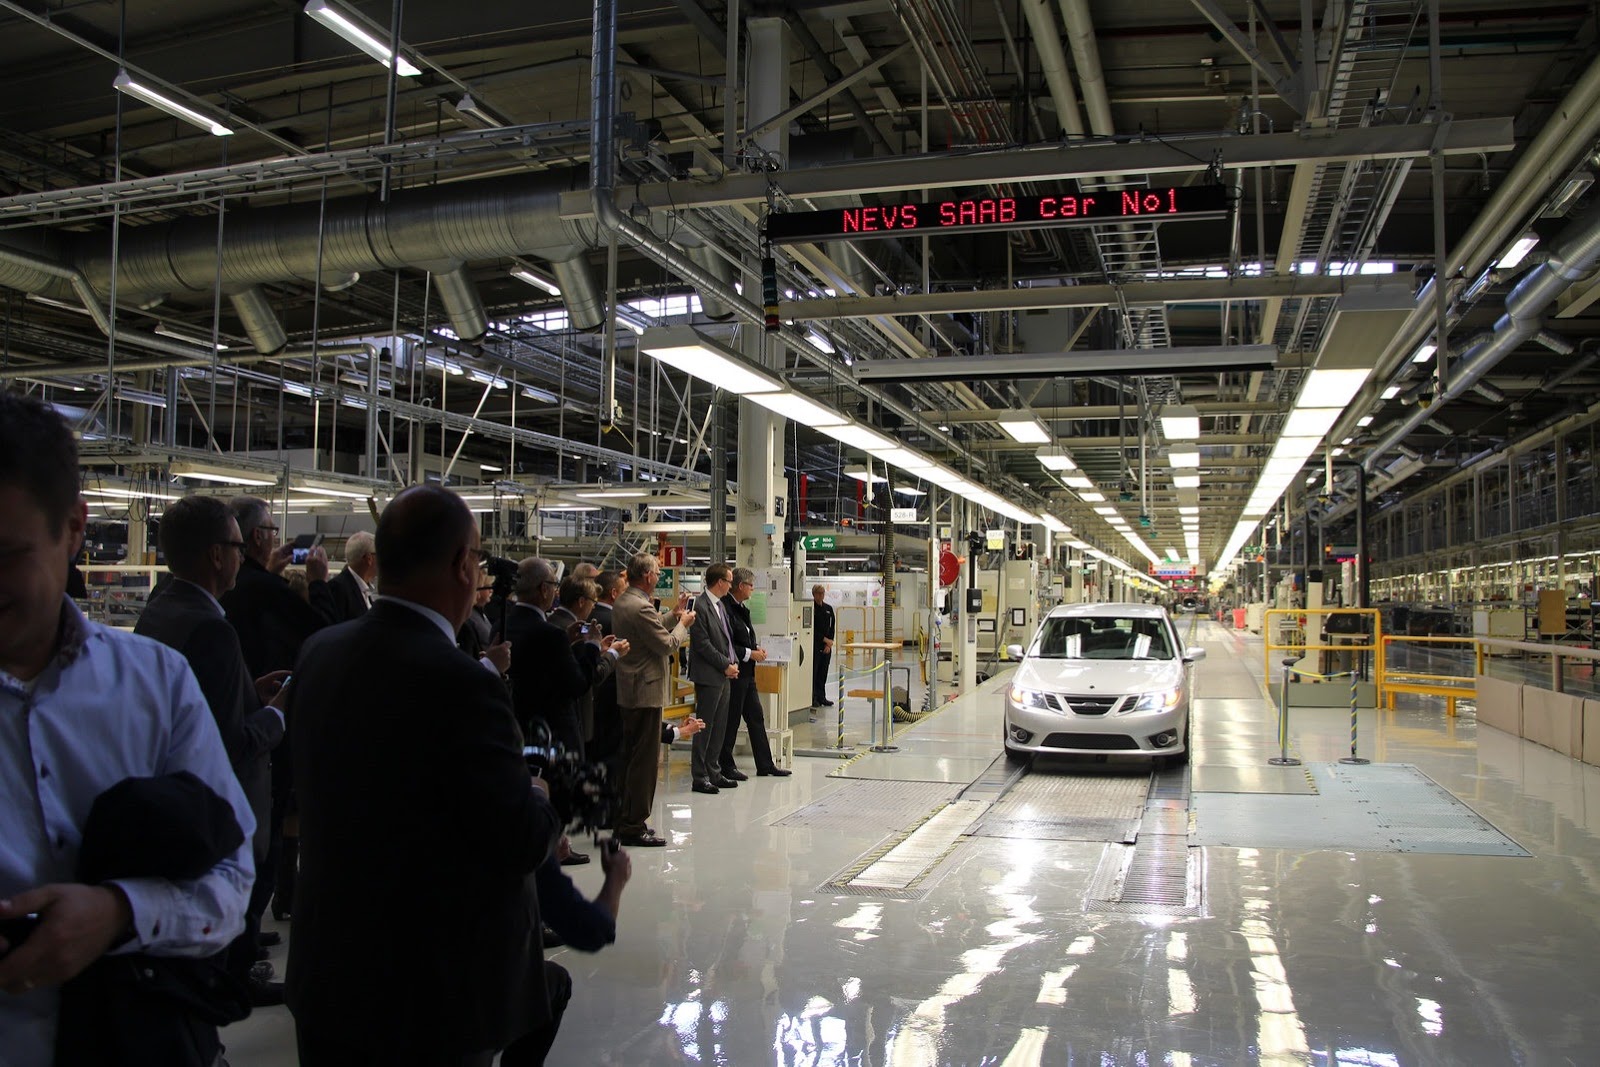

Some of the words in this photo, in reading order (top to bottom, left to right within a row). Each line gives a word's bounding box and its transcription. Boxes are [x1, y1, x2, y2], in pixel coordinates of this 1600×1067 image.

[843, 206, 917, 232] NEVS
[941, 199, 1016, 226] SAAB
[1041, 198, 1095, 218] car
[1122, 189, 1177, 215] No1
